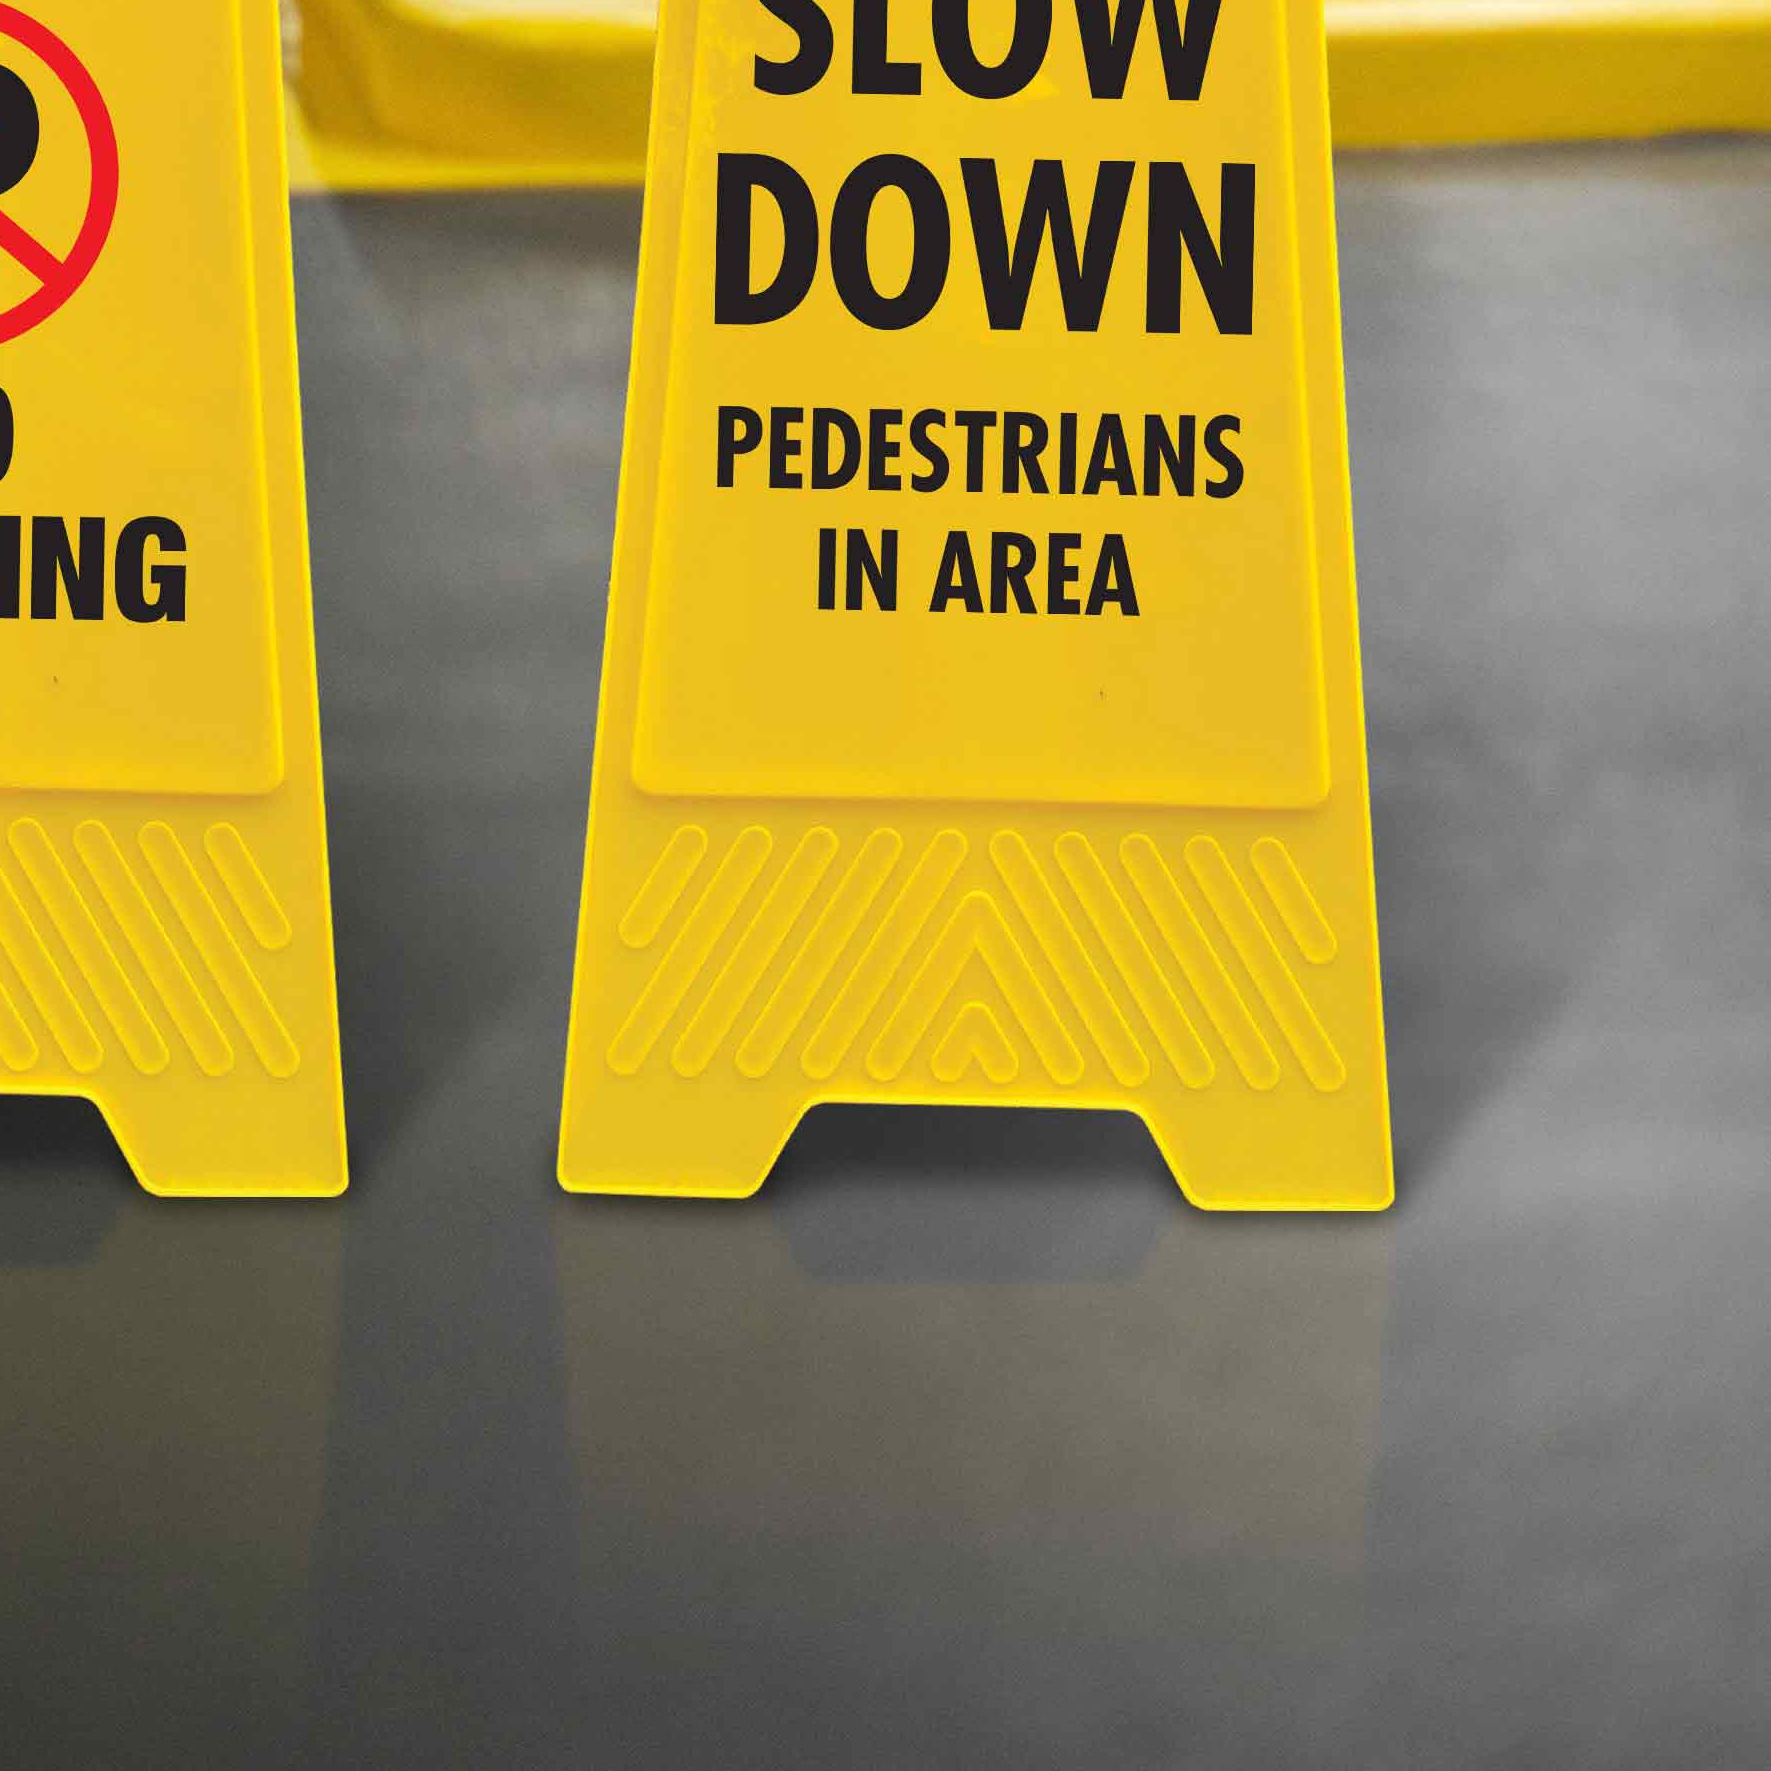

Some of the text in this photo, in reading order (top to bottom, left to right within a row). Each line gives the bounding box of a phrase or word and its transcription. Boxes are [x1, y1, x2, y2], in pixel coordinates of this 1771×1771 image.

[715, 153, 1255, 334] DOWN
[717, 406, 1243, 498] PEDESTRIANS
[819, 529, 1139, 616] IN AREA
